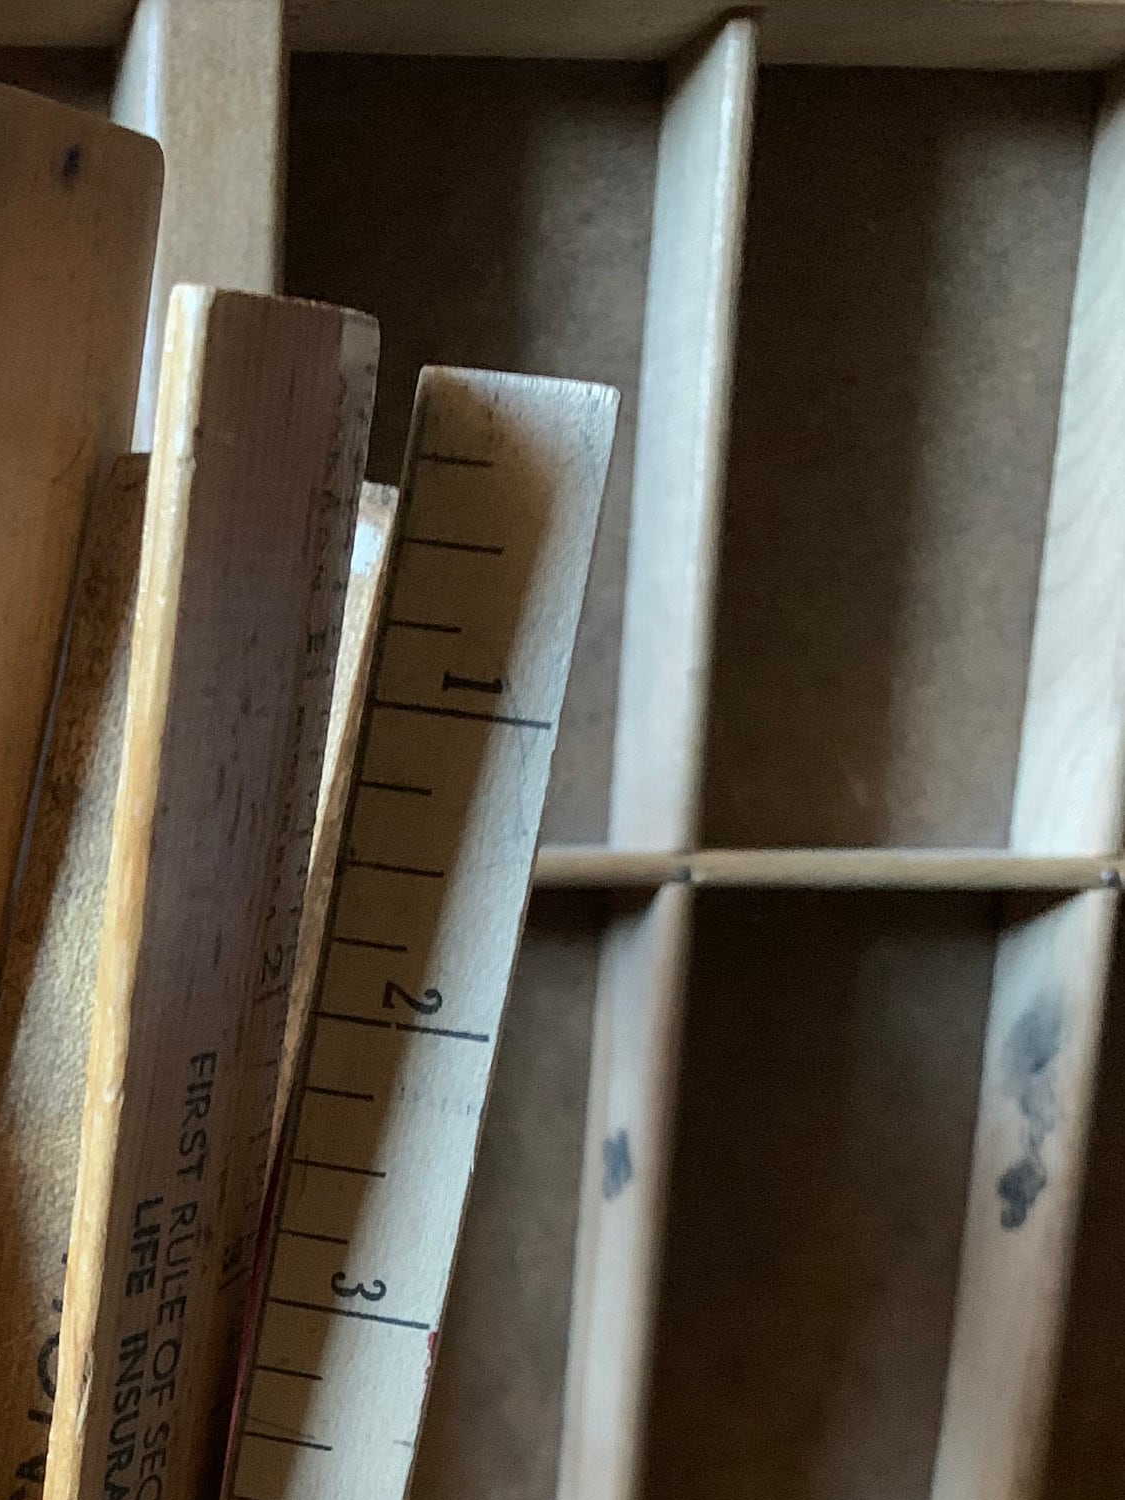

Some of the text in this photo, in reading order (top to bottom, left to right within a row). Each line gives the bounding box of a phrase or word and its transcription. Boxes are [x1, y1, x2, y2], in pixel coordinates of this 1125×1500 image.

[441, 671, 503, 694] 1
[382, 980, 443, 1016] 2
[177, 1050, 217, 1182] FIRST
[125, 1196, 164, 1298] LIFE
[158, 1201, 198, 1327] RULE
[330, 1270, 387, 1303] 3
[146, 1337, 181, 1408] OF
